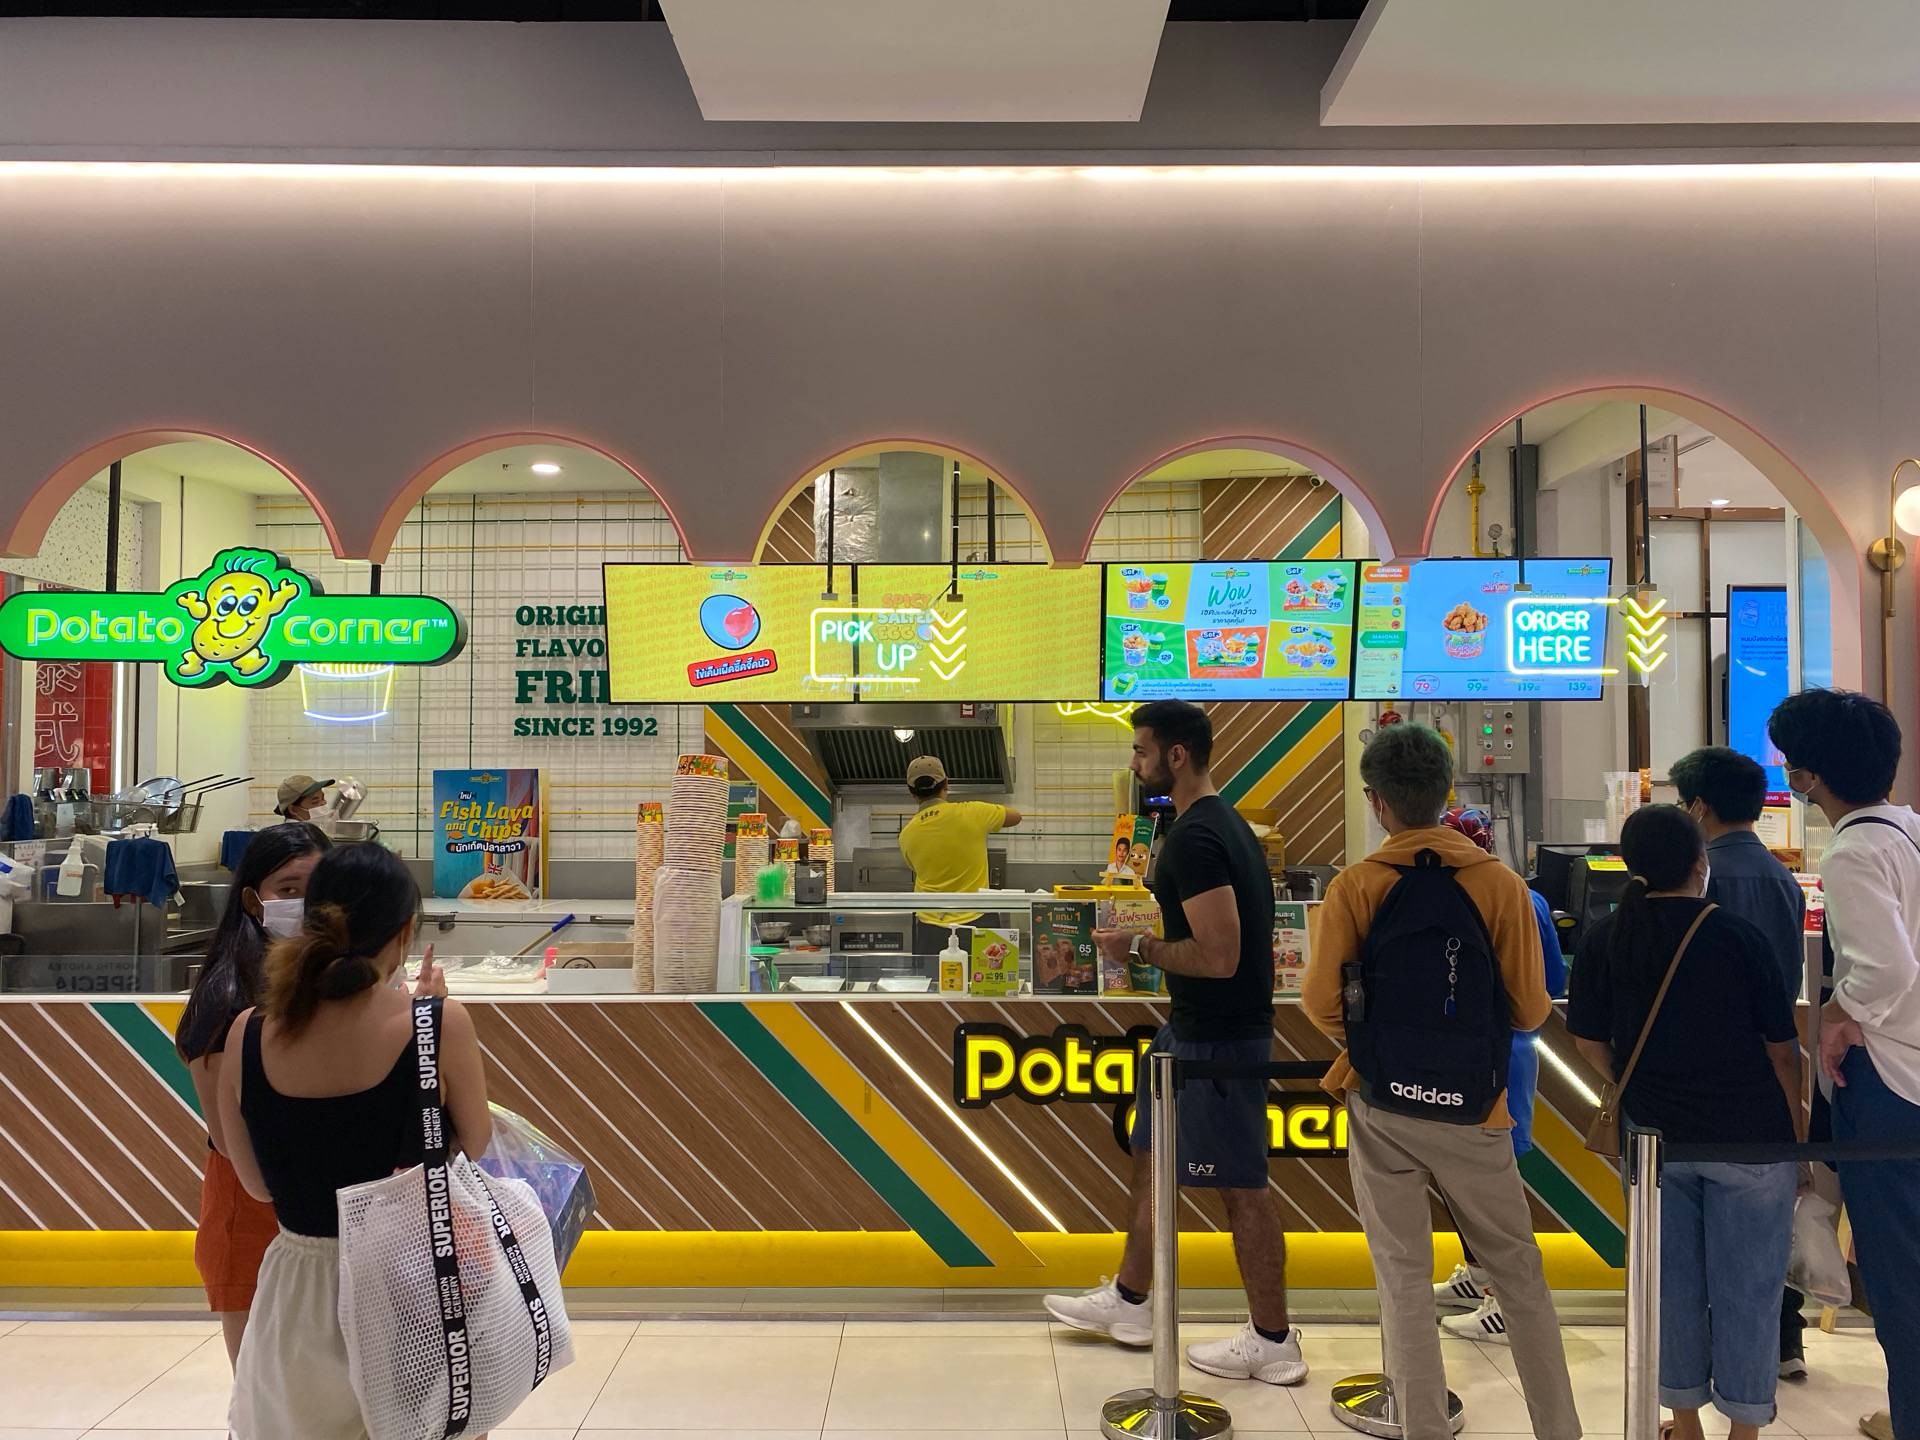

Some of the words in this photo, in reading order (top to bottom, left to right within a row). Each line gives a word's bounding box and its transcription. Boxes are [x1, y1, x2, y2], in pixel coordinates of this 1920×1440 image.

[1208, 581, 1251, 607] Wow
[27, 608, 184, 647] Potato
[283, 615, 430, 647] Corner
[820, 620, 875, 643] PICK
[1516, 610, 1591, 631] ORDER
[877, 643, 917, 671] UP
[1519, 635, 1592, 663] HERE
[1467, 682, 1482, 691] 99
[1569, 682, 1586, 691] 139
[514, 718, 595, 736] SINCE
[602, 718, 658, 736] 1992
[440, 800, 481, 821] Fish
[484, 801, 534, 821] Lava
[445, 821, 466, 831] and
[467, 819, 522, 842] Chips
[1079, 944, 1092, 954] 65
[415, 1004, 438, 1090] SUPERIOR
[966, 1034, 1152, 1100] Pota
[1390, 1082, 1464, 1106] adidas
[433, 1107, 443, 1149] SCENERY
[1188, 1162, 1215, 1174] EA7
[428, 1165, 453, 1258] SUPERIOR
[506, 1246, 526, 1285] SCENERY
[513, 1244, 531, 1282] FASHION
[440, 1276, 453, 1320] FASHION
[449, 1275, 463, 1319] SCENERY
[529, 1297, 550, 1382] SUPERIOR
[451, 1328, 470, 1420] SUPERIOR
